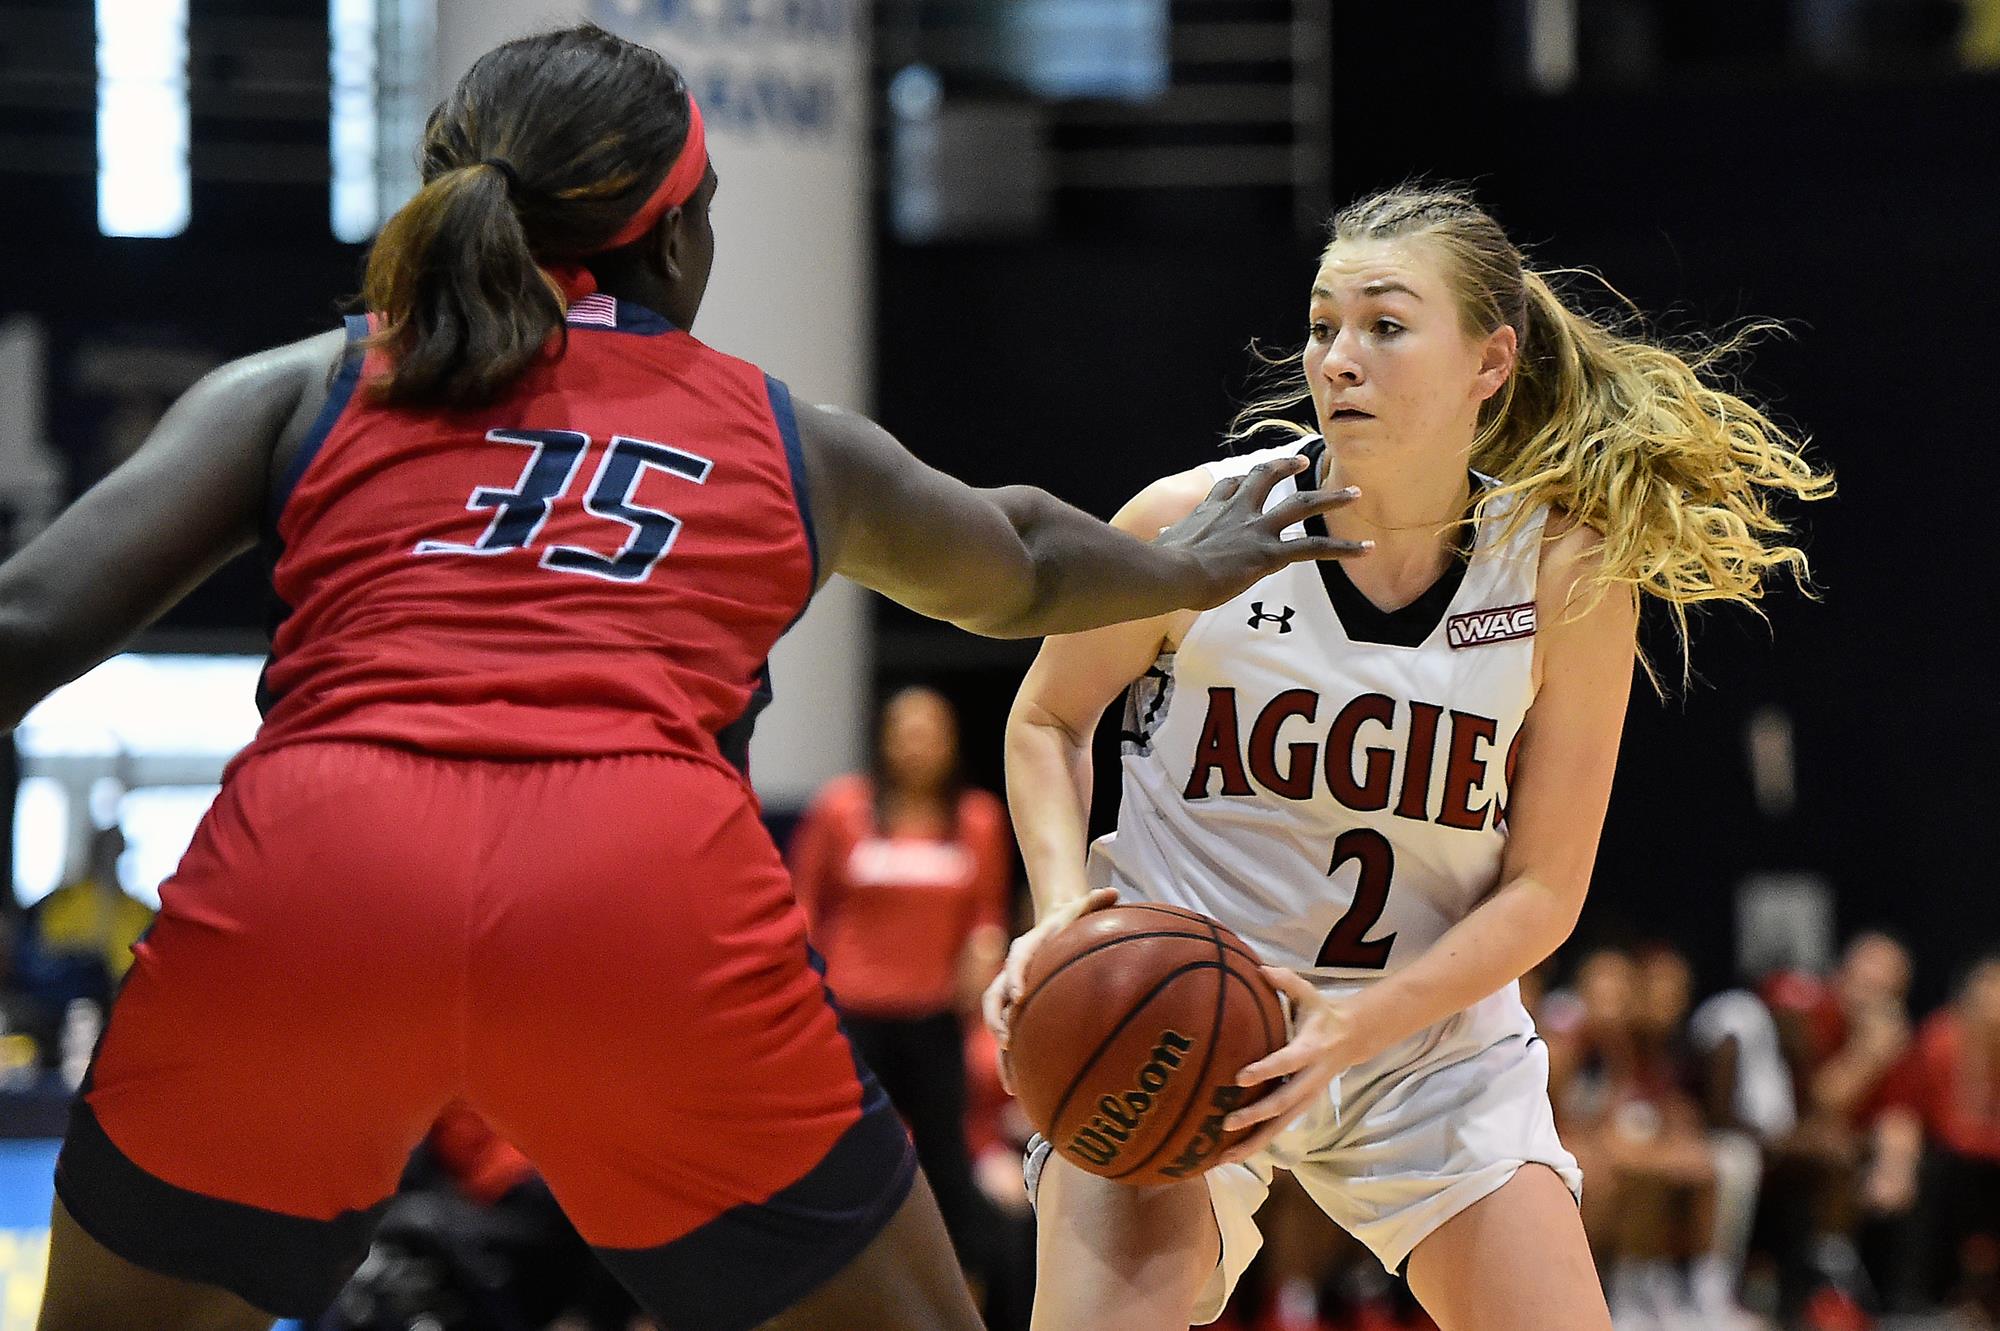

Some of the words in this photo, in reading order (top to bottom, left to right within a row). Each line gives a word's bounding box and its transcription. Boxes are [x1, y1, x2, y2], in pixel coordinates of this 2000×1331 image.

[412, 428, 705, 583] 35
[1453, 608, 1534, 643] WAC
[1314, 827, 1398, 970] 2
[1068, 1029, 1195, 1167] Wilson
